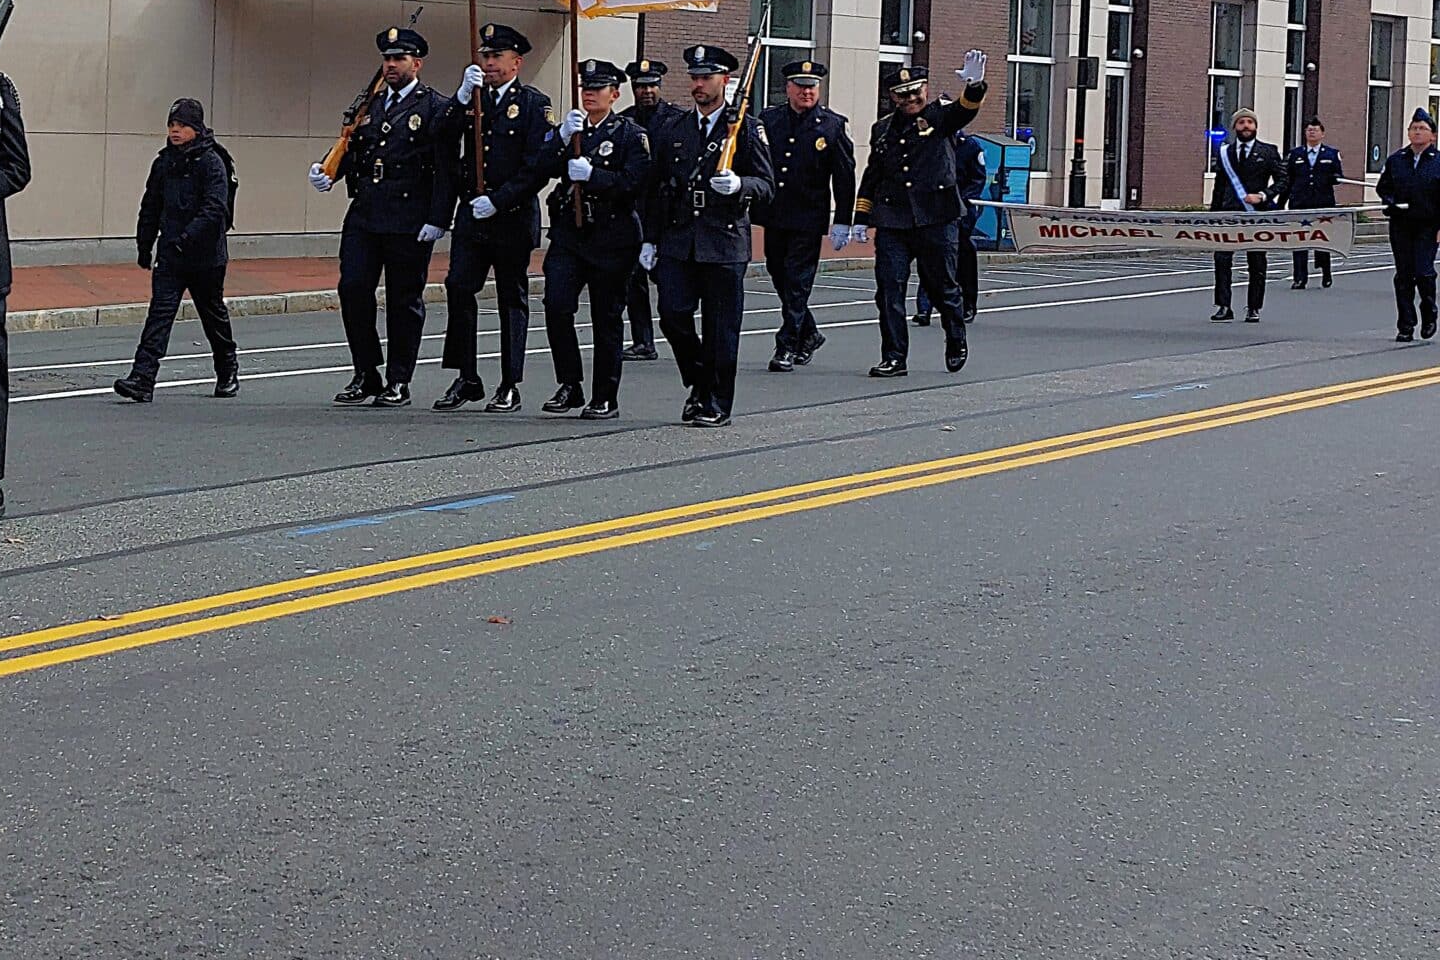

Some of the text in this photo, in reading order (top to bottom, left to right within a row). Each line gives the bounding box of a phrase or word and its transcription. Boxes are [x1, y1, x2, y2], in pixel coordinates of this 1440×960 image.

[1174, 217, 1286, 225] MARSHAL
[1039, 224, 1329, 243] MICHAEL ARILLOTTA
